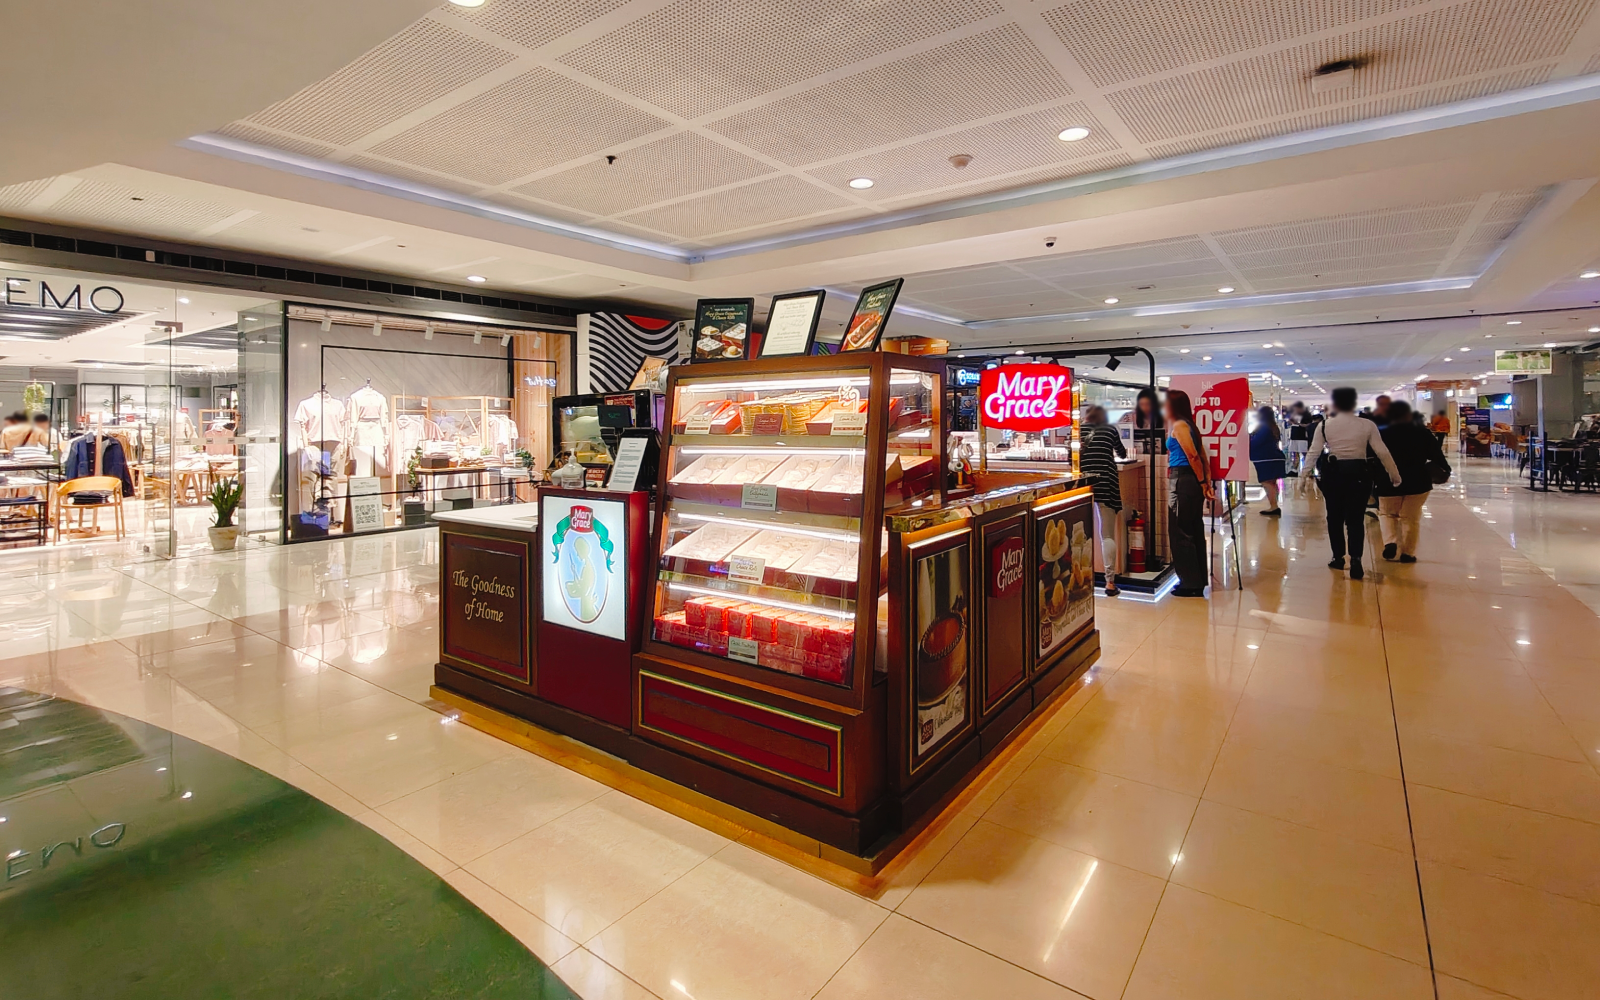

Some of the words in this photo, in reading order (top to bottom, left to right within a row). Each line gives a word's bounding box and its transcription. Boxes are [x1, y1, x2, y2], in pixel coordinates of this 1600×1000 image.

[996, 371, 1066, 404] Mary
[1201, 381, 1214, 391] blk
[985, 392, 1058, 423] Grace
[1195, 396, 1207, 406] UP
[1209, 396, 1221, 406] TO
[1191, 409, 1237, 435] 0%
[1201, 436, 1239, 469] FF
[571, 517, 591, 529] Grace
[574, 508, 593, 521] Mary
[1001, 547, 1025, 569] Mary
[453, 570, 469, 587] The
[471, 574, 515, 598] Goodness
[997, 565, 1023, 592] Grace
[464, 598, 477, 620] of
[475, 602, 504, 622] Home
